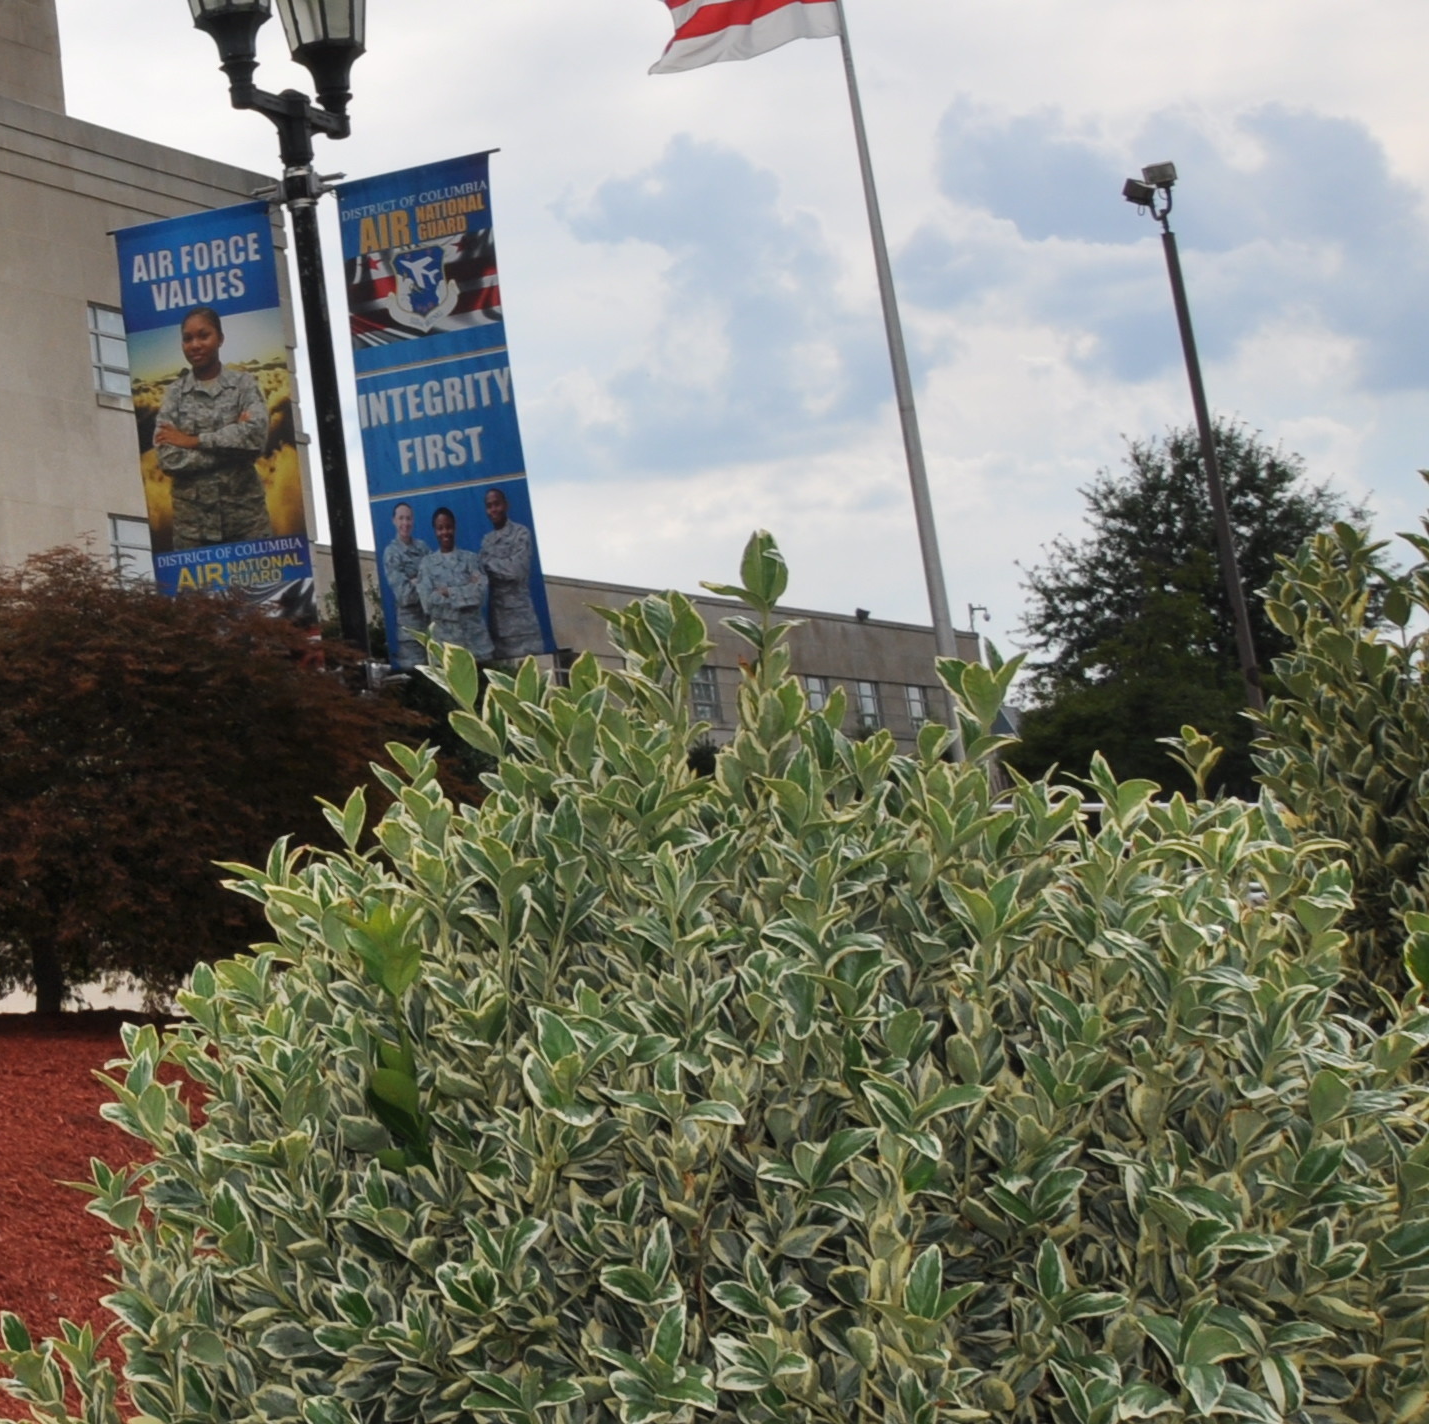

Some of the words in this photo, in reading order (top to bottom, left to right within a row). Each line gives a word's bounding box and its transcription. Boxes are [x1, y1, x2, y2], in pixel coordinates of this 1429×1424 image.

[342, 199, 397, 222] DISTRICT
[399, 194, 417, 208] OF
[418, 179, 488, 203] COLUMBIA
[359, 209, 411, 255] AIR
[415, 193, 485, 223] NATIONAL
[417, 214, 468, 241] GUARD
[132, 249, 174, 284] AIR
[180, 232, 262, 274] FORCE
[151, 268, 246, 312] VALUES
[357, 366, 511, 430] INTEGRITY
[397, 426, 484, 475] FIRST
[157, 549, 213, 569] DISTRICT
[215, 546, 232, 560] OF
[234, 536, 303, 557] COLUMBIA
[176, 562, 226, 594] AIR
[226, 552, 304, 574] NATIONAL
[228, 568, 283, 588] GUARD
